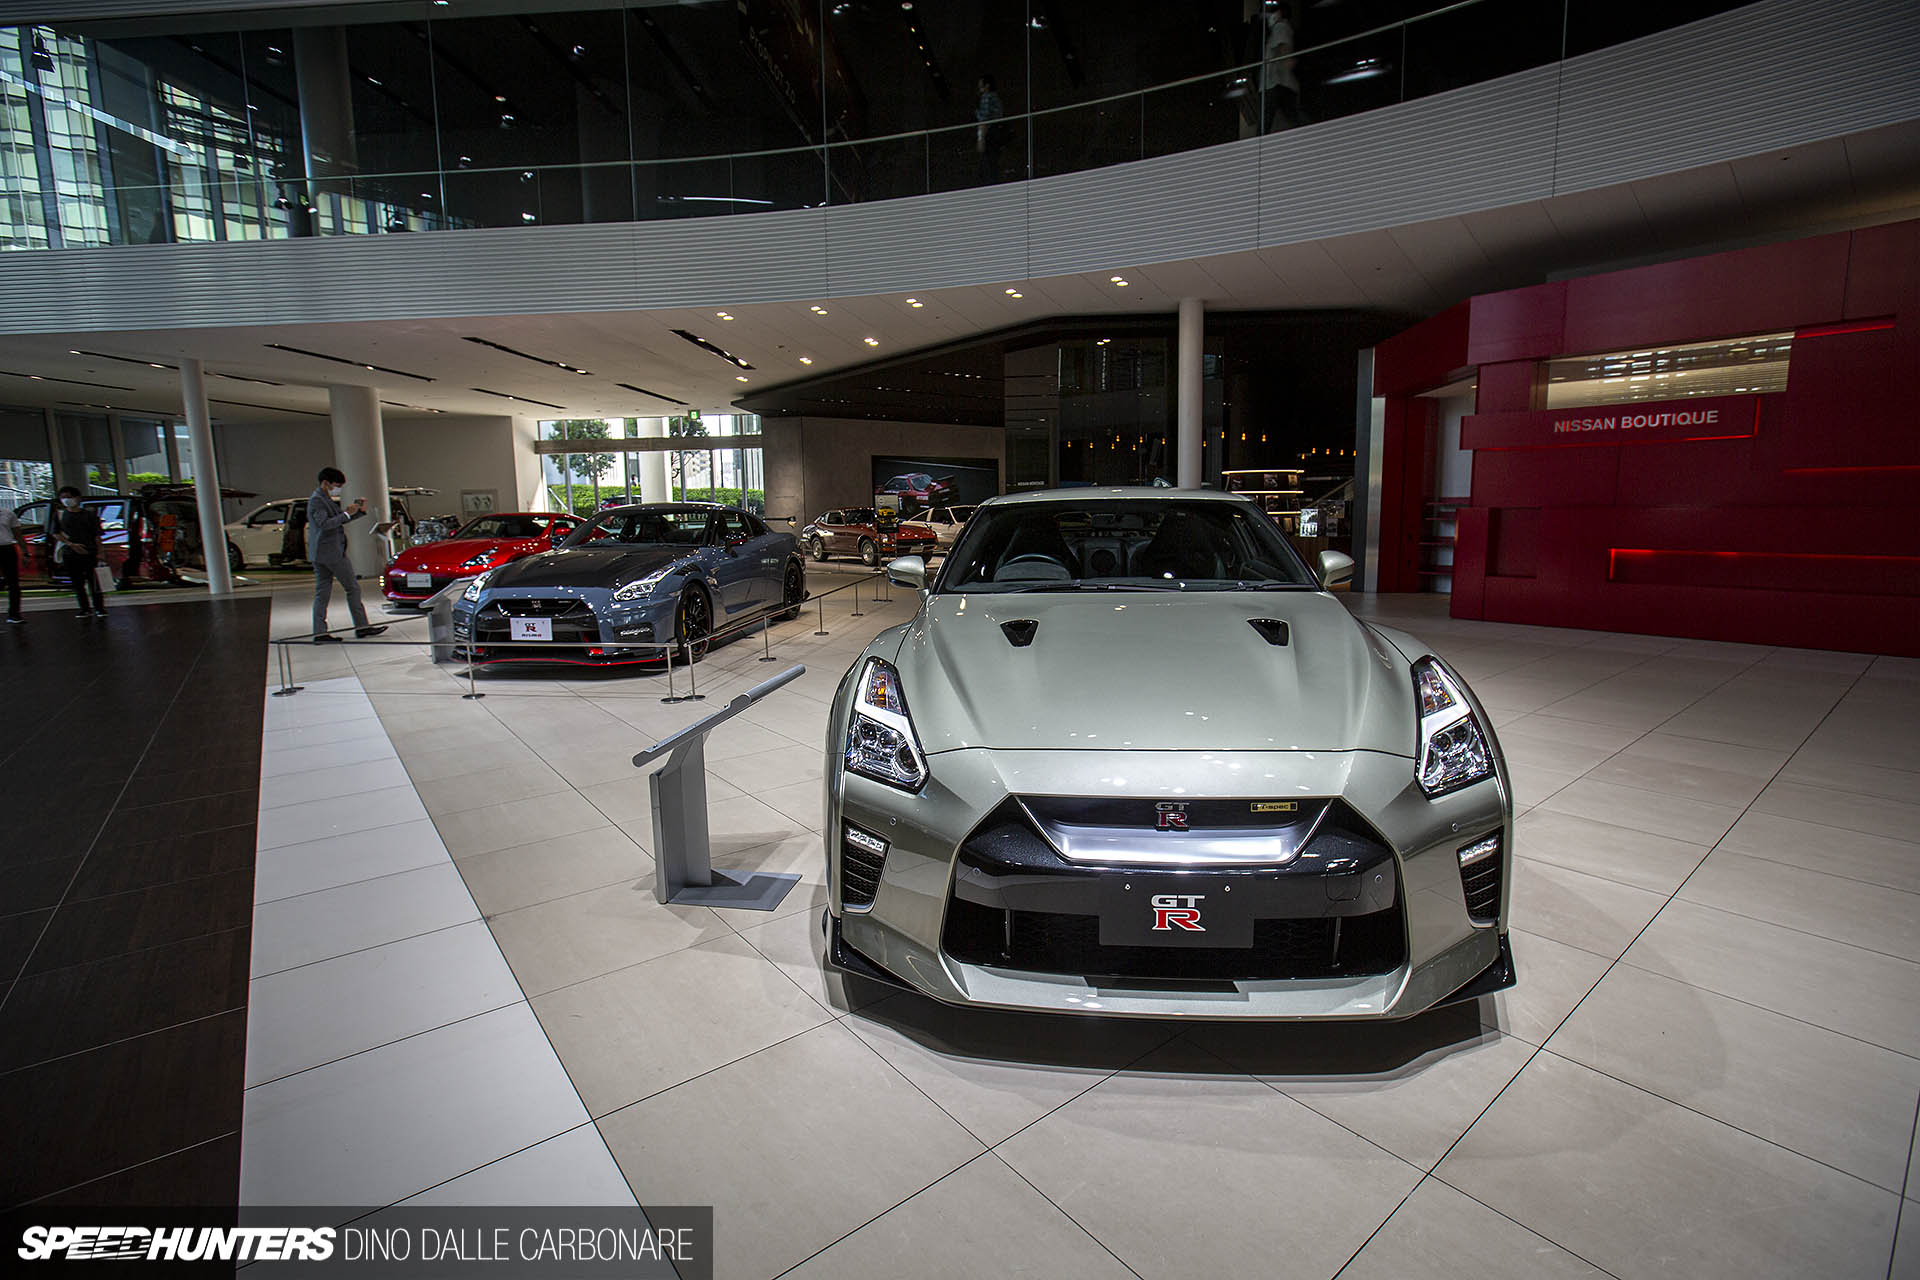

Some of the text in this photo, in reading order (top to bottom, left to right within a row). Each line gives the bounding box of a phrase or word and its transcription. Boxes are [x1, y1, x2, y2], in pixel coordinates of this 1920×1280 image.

[1554, 410, 1719, 433] NISSAN BOUTIQUE
[1151, 894, 1205, 908] GT
[1151, 907, 1206, 931] R
